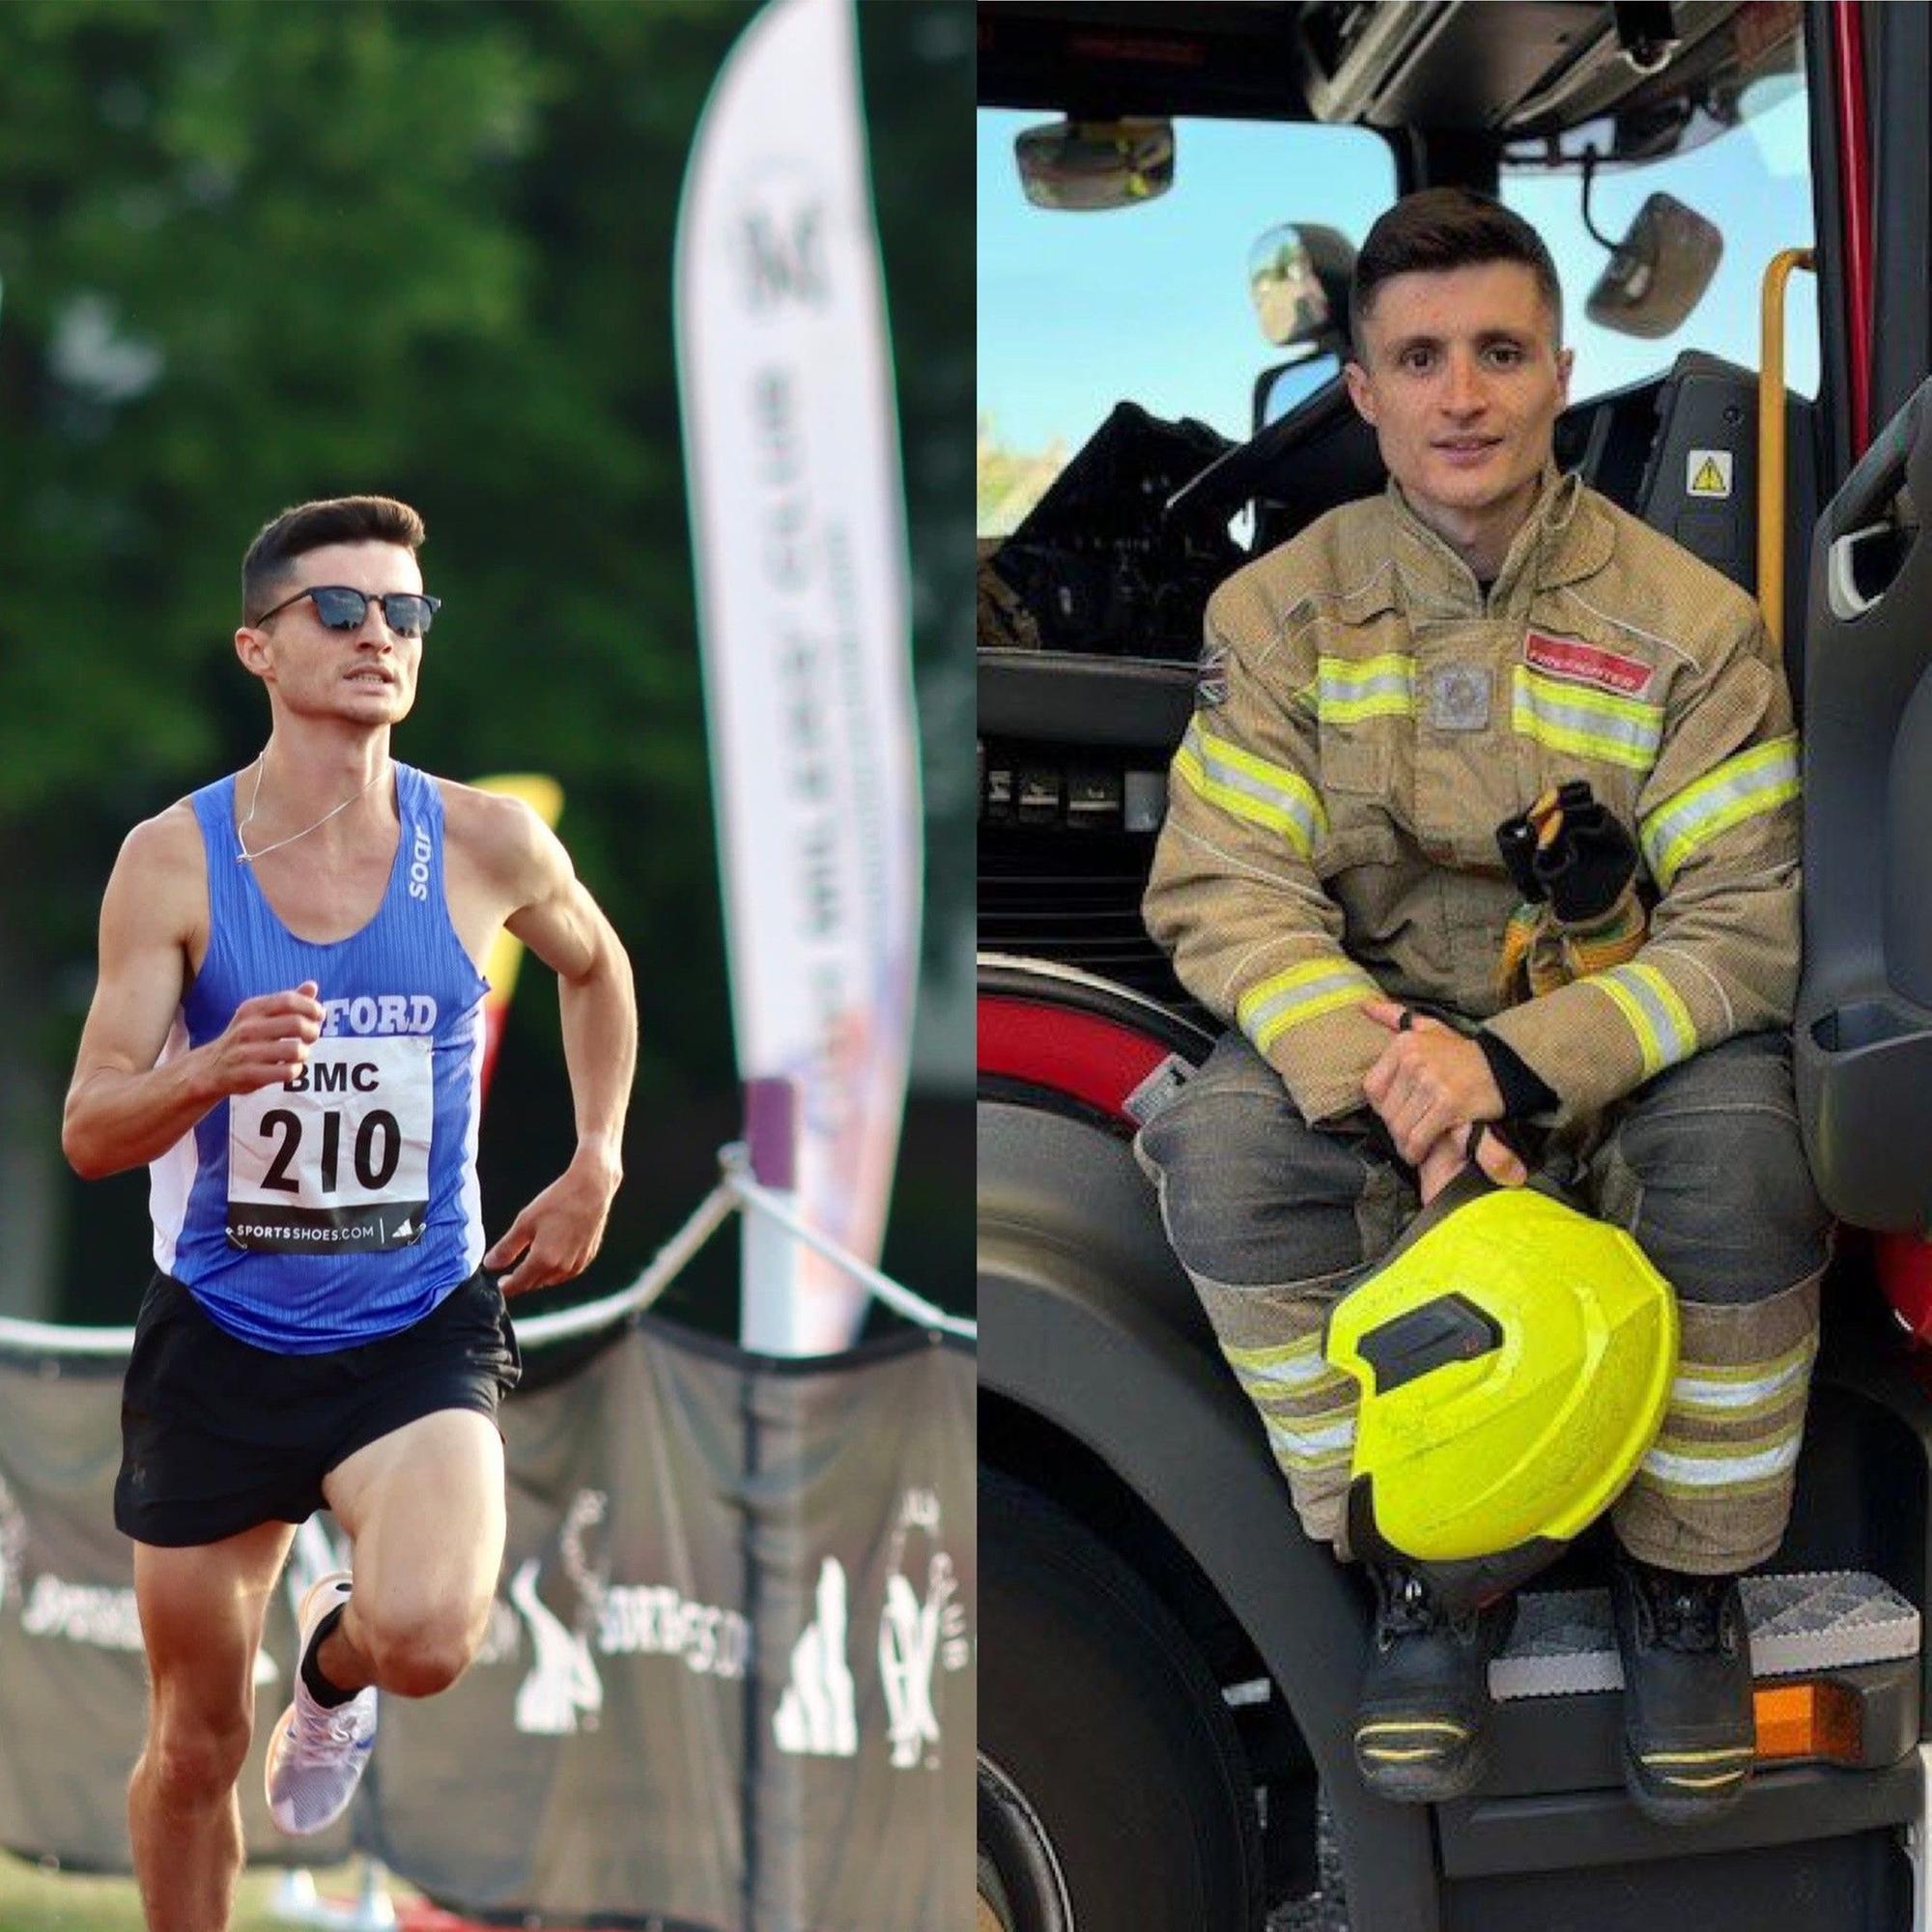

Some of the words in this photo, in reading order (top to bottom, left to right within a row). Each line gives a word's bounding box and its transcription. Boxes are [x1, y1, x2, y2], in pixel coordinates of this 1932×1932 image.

[409, 825, 432, 901] soar
[323, 995, 438, 1037] FORD
[283, 1062, 380, 1092] BMC
[260, 1109, 401, 1194] 210
